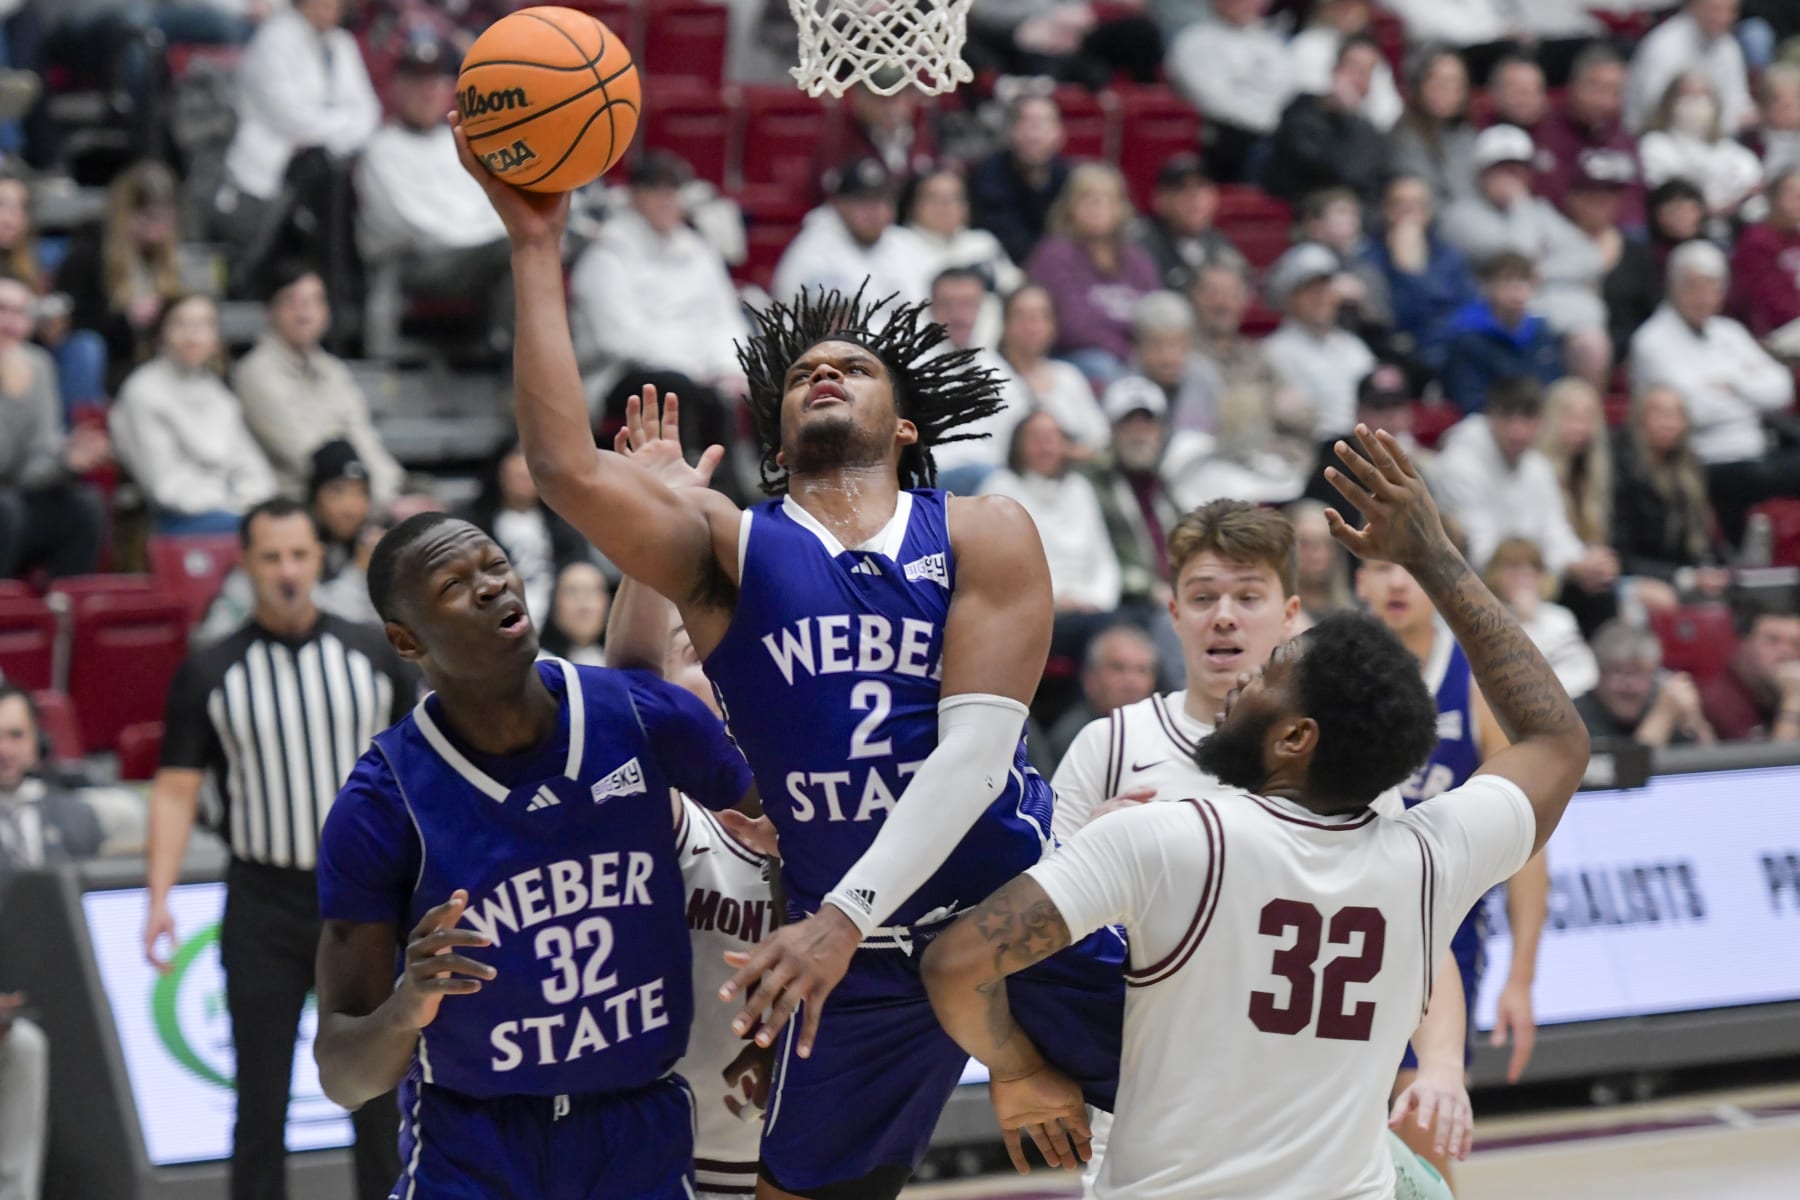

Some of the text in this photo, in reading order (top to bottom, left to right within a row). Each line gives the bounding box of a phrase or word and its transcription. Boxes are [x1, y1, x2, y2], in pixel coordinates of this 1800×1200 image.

[480, 139, 536, 172] CAA
[761, 614, 943, 686] WEBE
[847, 679, 893, 760] 2
[785, 759, 926, 822] STA
[464, 851, 654, 947] WEBER
[534, 916, 618, 1005] 32
[1248, 898, 1386, 1041] 32
[490, 977, 669, 1072] STATE
